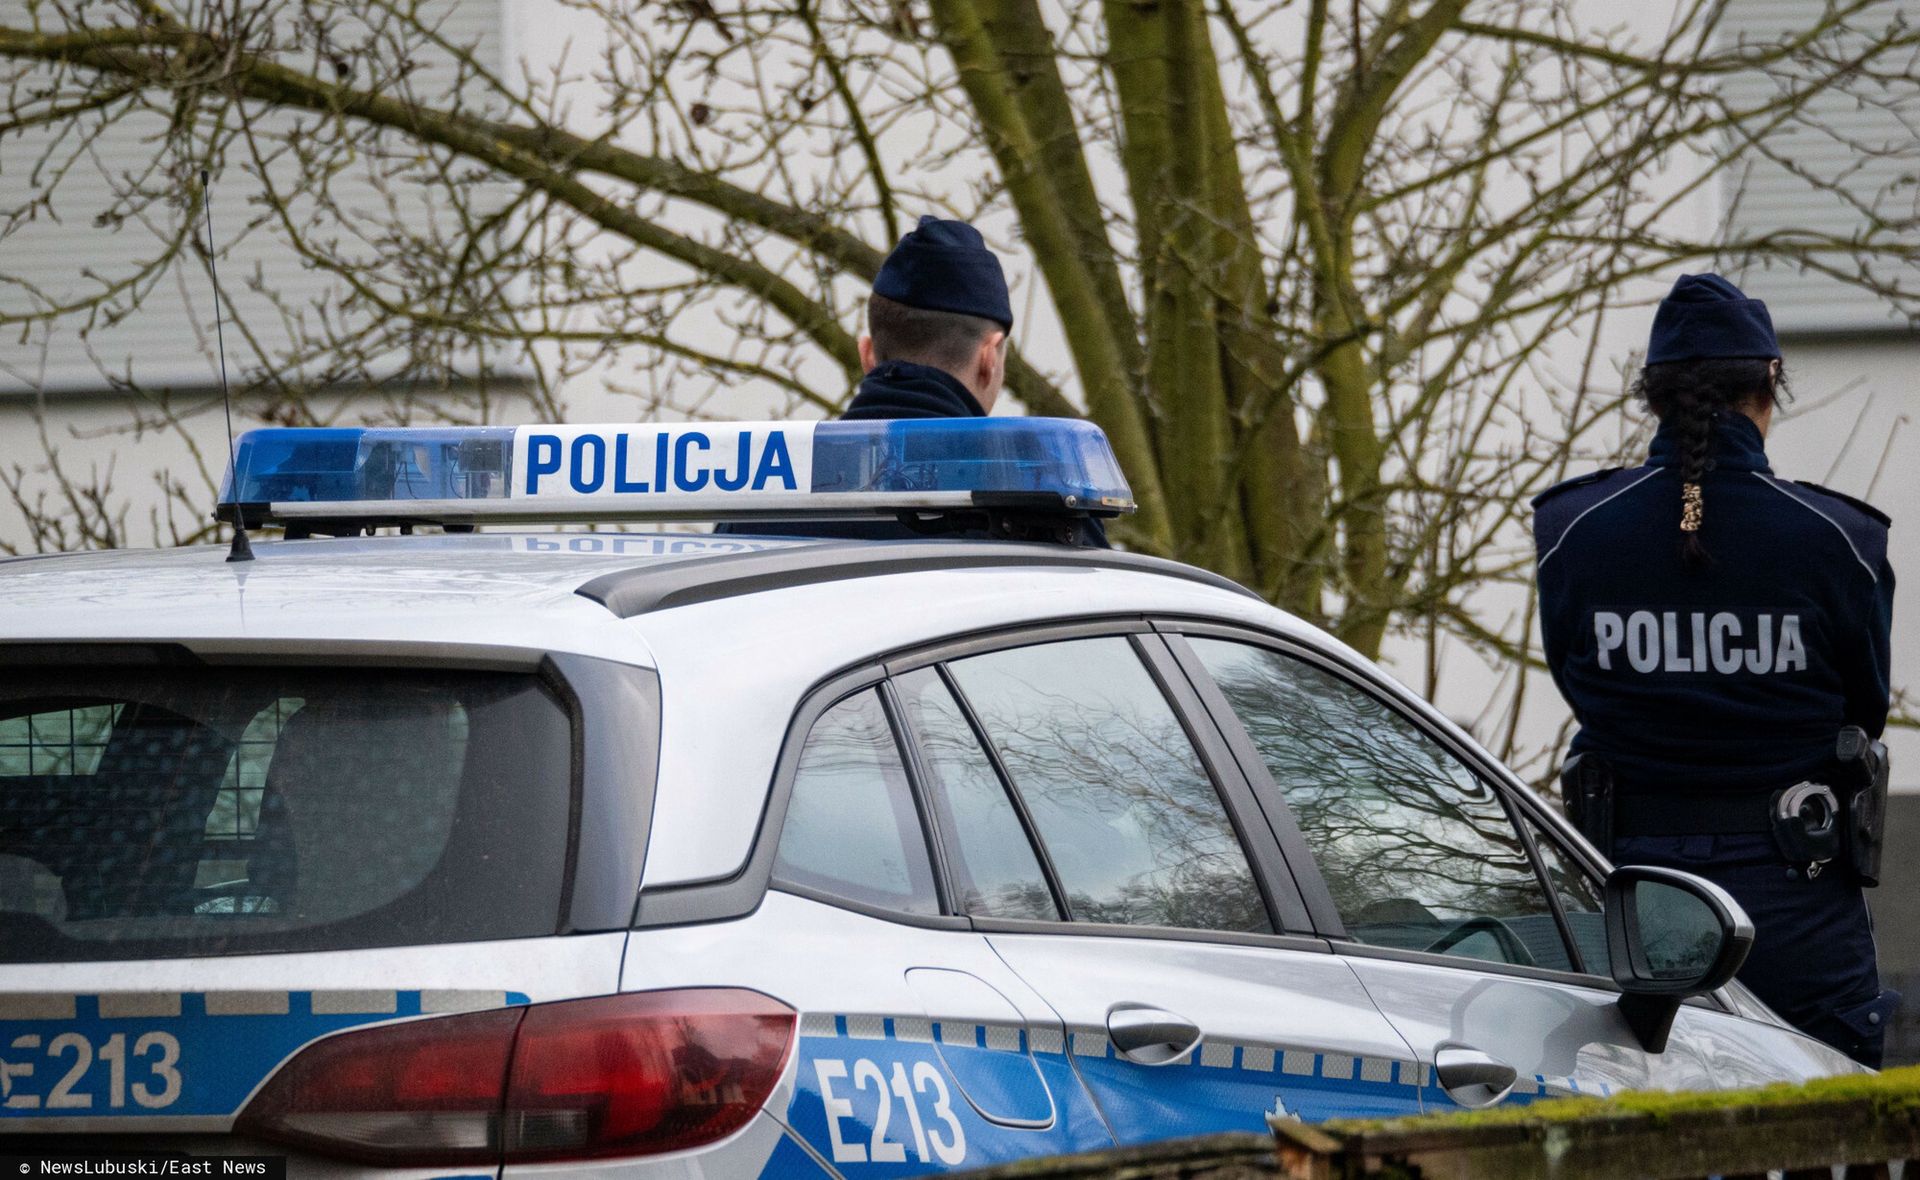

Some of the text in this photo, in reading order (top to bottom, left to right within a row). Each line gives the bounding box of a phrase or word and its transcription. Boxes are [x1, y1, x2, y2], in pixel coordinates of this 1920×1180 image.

[526, 430, 797, 495] POLICJA
[1594, 610, 1807, 675] POLICJA
[813, 1058, 966, 1165] E213
